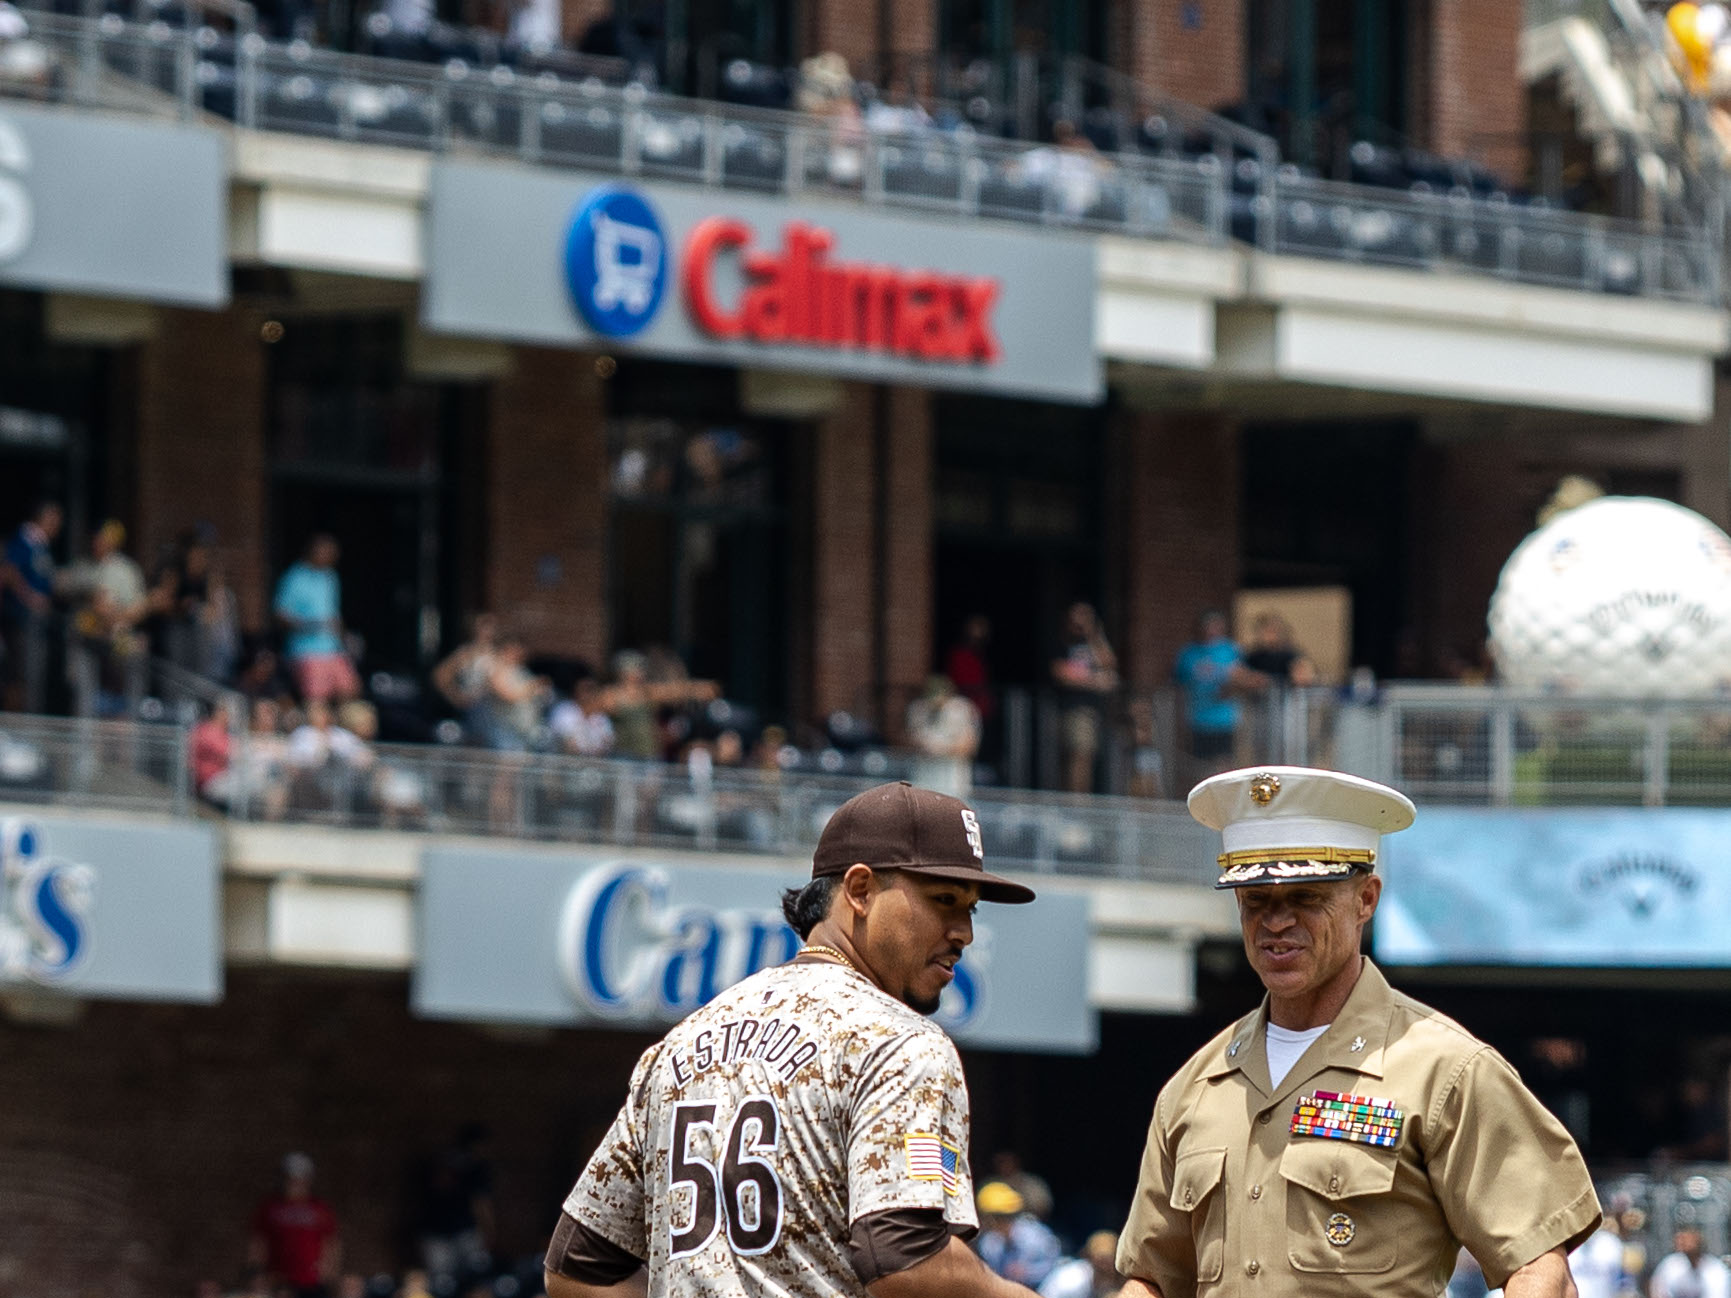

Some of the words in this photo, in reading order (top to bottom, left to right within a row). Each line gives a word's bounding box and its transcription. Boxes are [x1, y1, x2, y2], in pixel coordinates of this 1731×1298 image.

[682, 214, 1002, 366] Calimax
[670, 1017, 819, 1088] ESTRADA
[669, 1094, 784, 1260] 56
